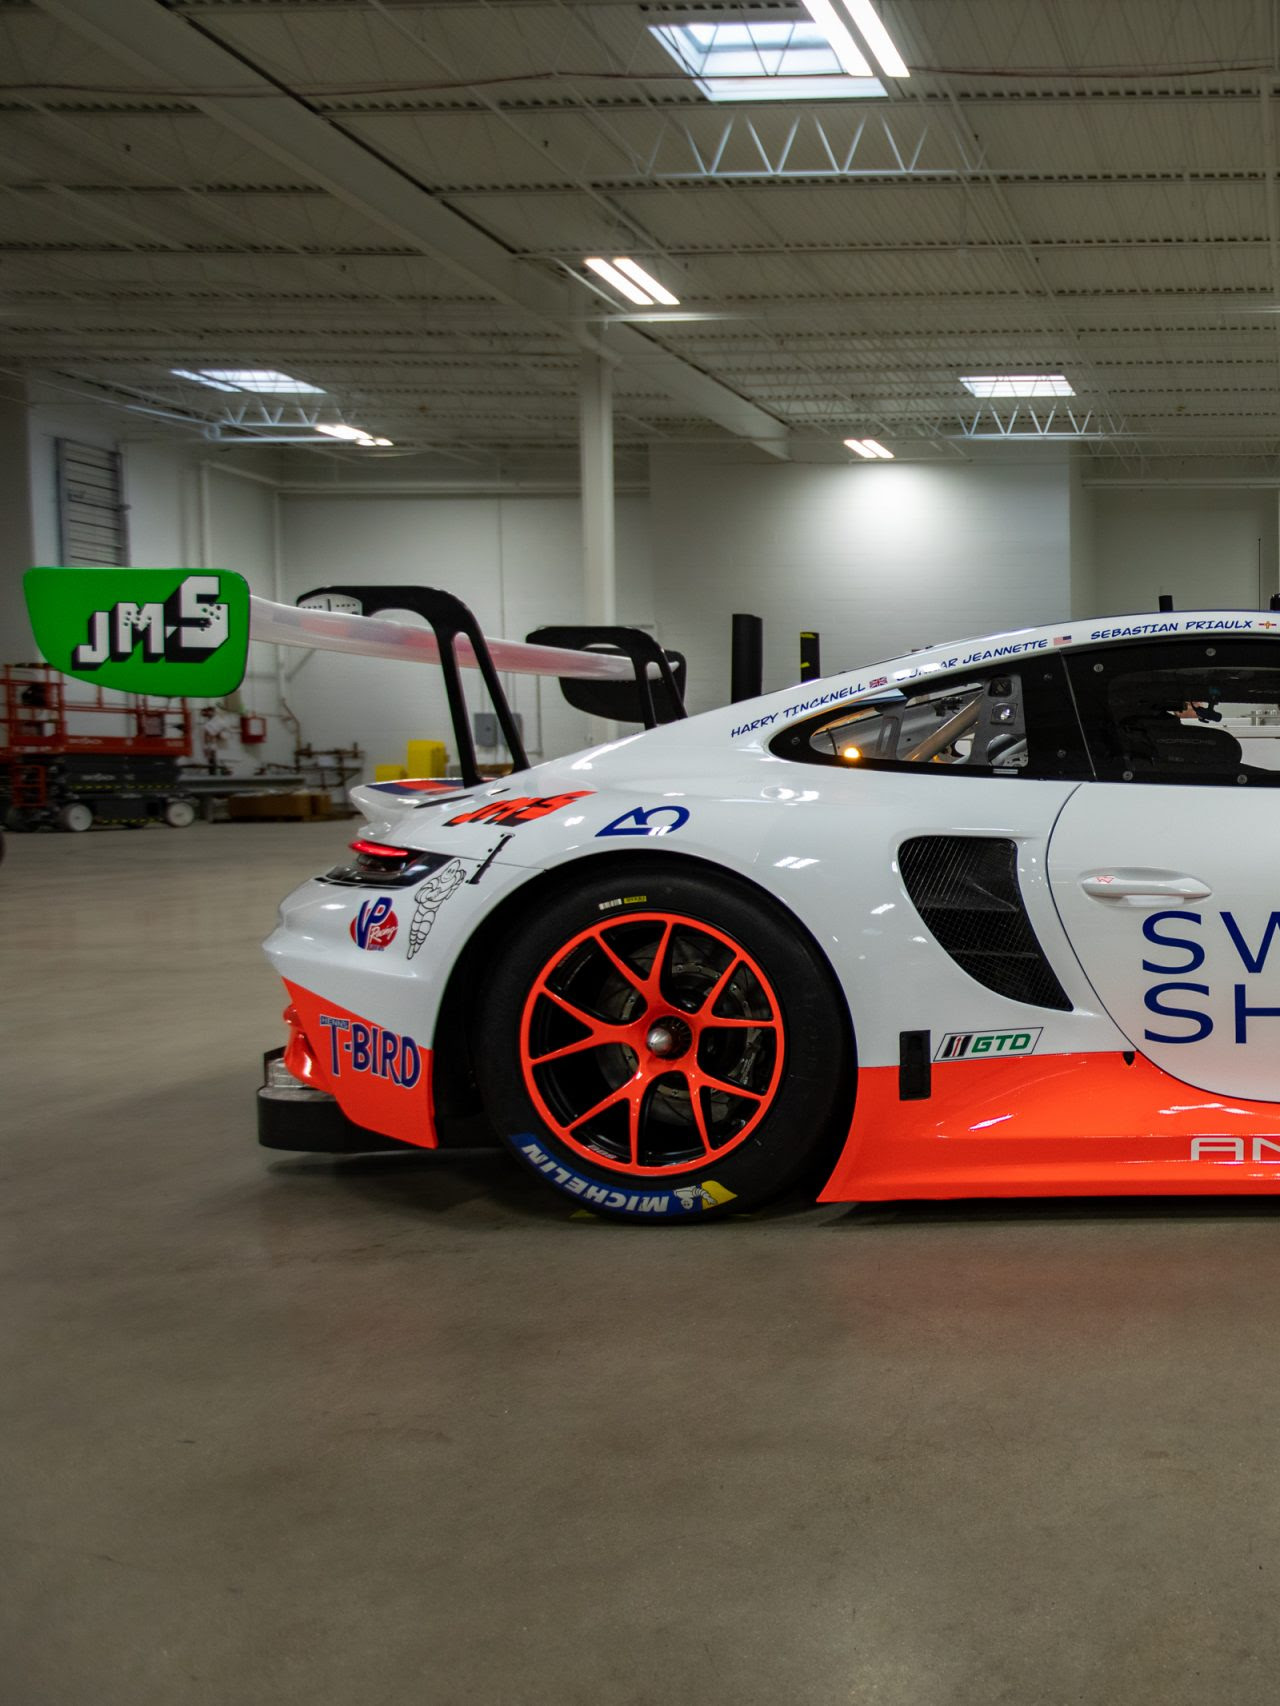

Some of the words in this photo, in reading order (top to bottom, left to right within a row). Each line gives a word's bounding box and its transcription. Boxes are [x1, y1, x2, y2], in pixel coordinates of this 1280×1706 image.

[72, 575, 229, 671] JMS
[1091, 622, 1179, 640] SEBASTIAN
[1185, 620, 1253, 630] PRIAULX
[962, 638, 1048, 665] JEANNETTE
[730, 712, 779, 738] HARRY
[783, 683, 866, 719] TINCKNELL
[356, 896, 393, 950] VP
[319, 1014, 422, 1090] T-BIRD
[971, 1033, 1031, 1053] GTD
[521, 1143, 669, 1213] MICHELIN
